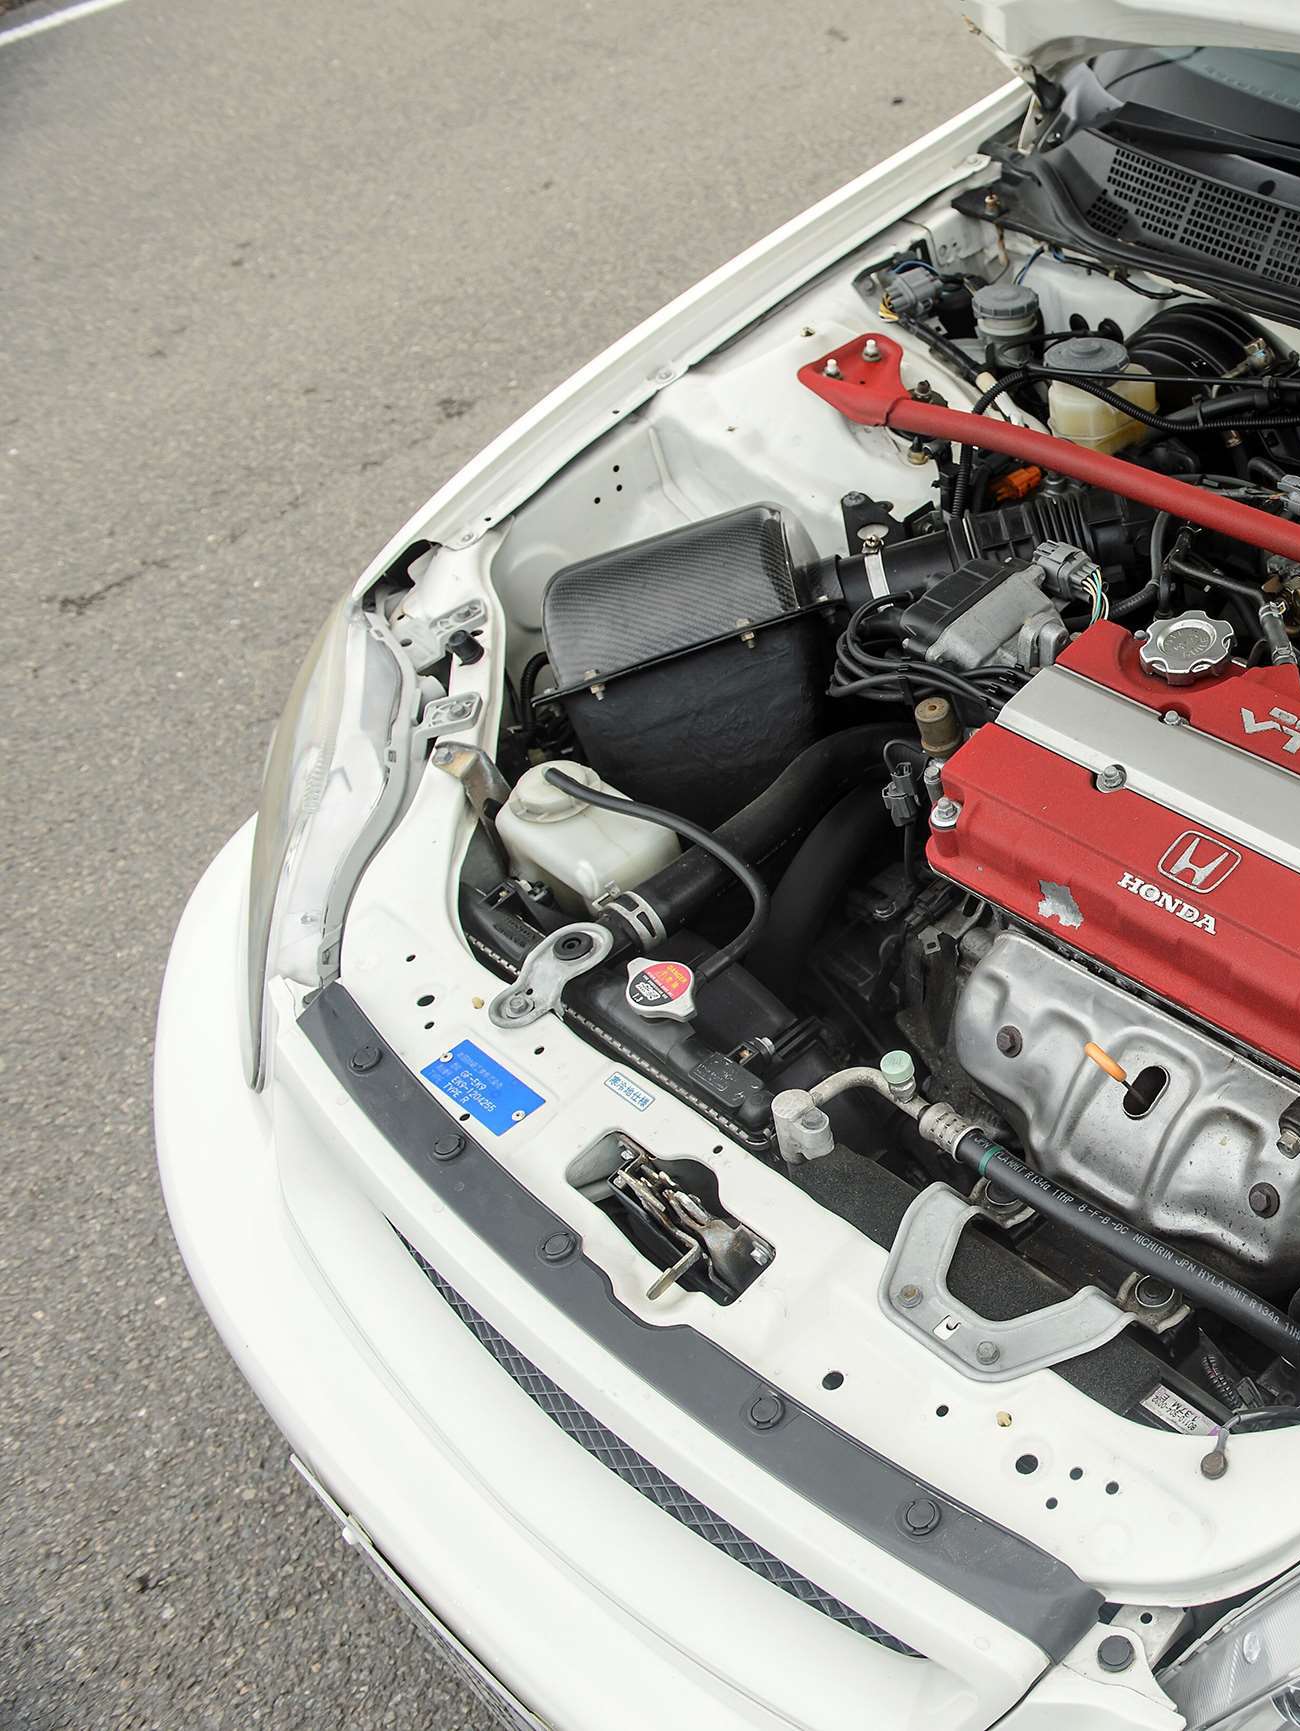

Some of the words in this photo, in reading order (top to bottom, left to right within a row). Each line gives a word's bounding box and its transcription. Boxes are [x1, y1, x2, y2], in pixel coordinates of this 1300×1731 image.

[1117, 872, 1216, 935] HONDA
[442, 1082, 462, 1098] TYPE
[460, 1095, 469, 1104] R
[1132, 1232, 1174, 1261] NICHIRIN
[1174, 1256, 1198, 1273] JPN
